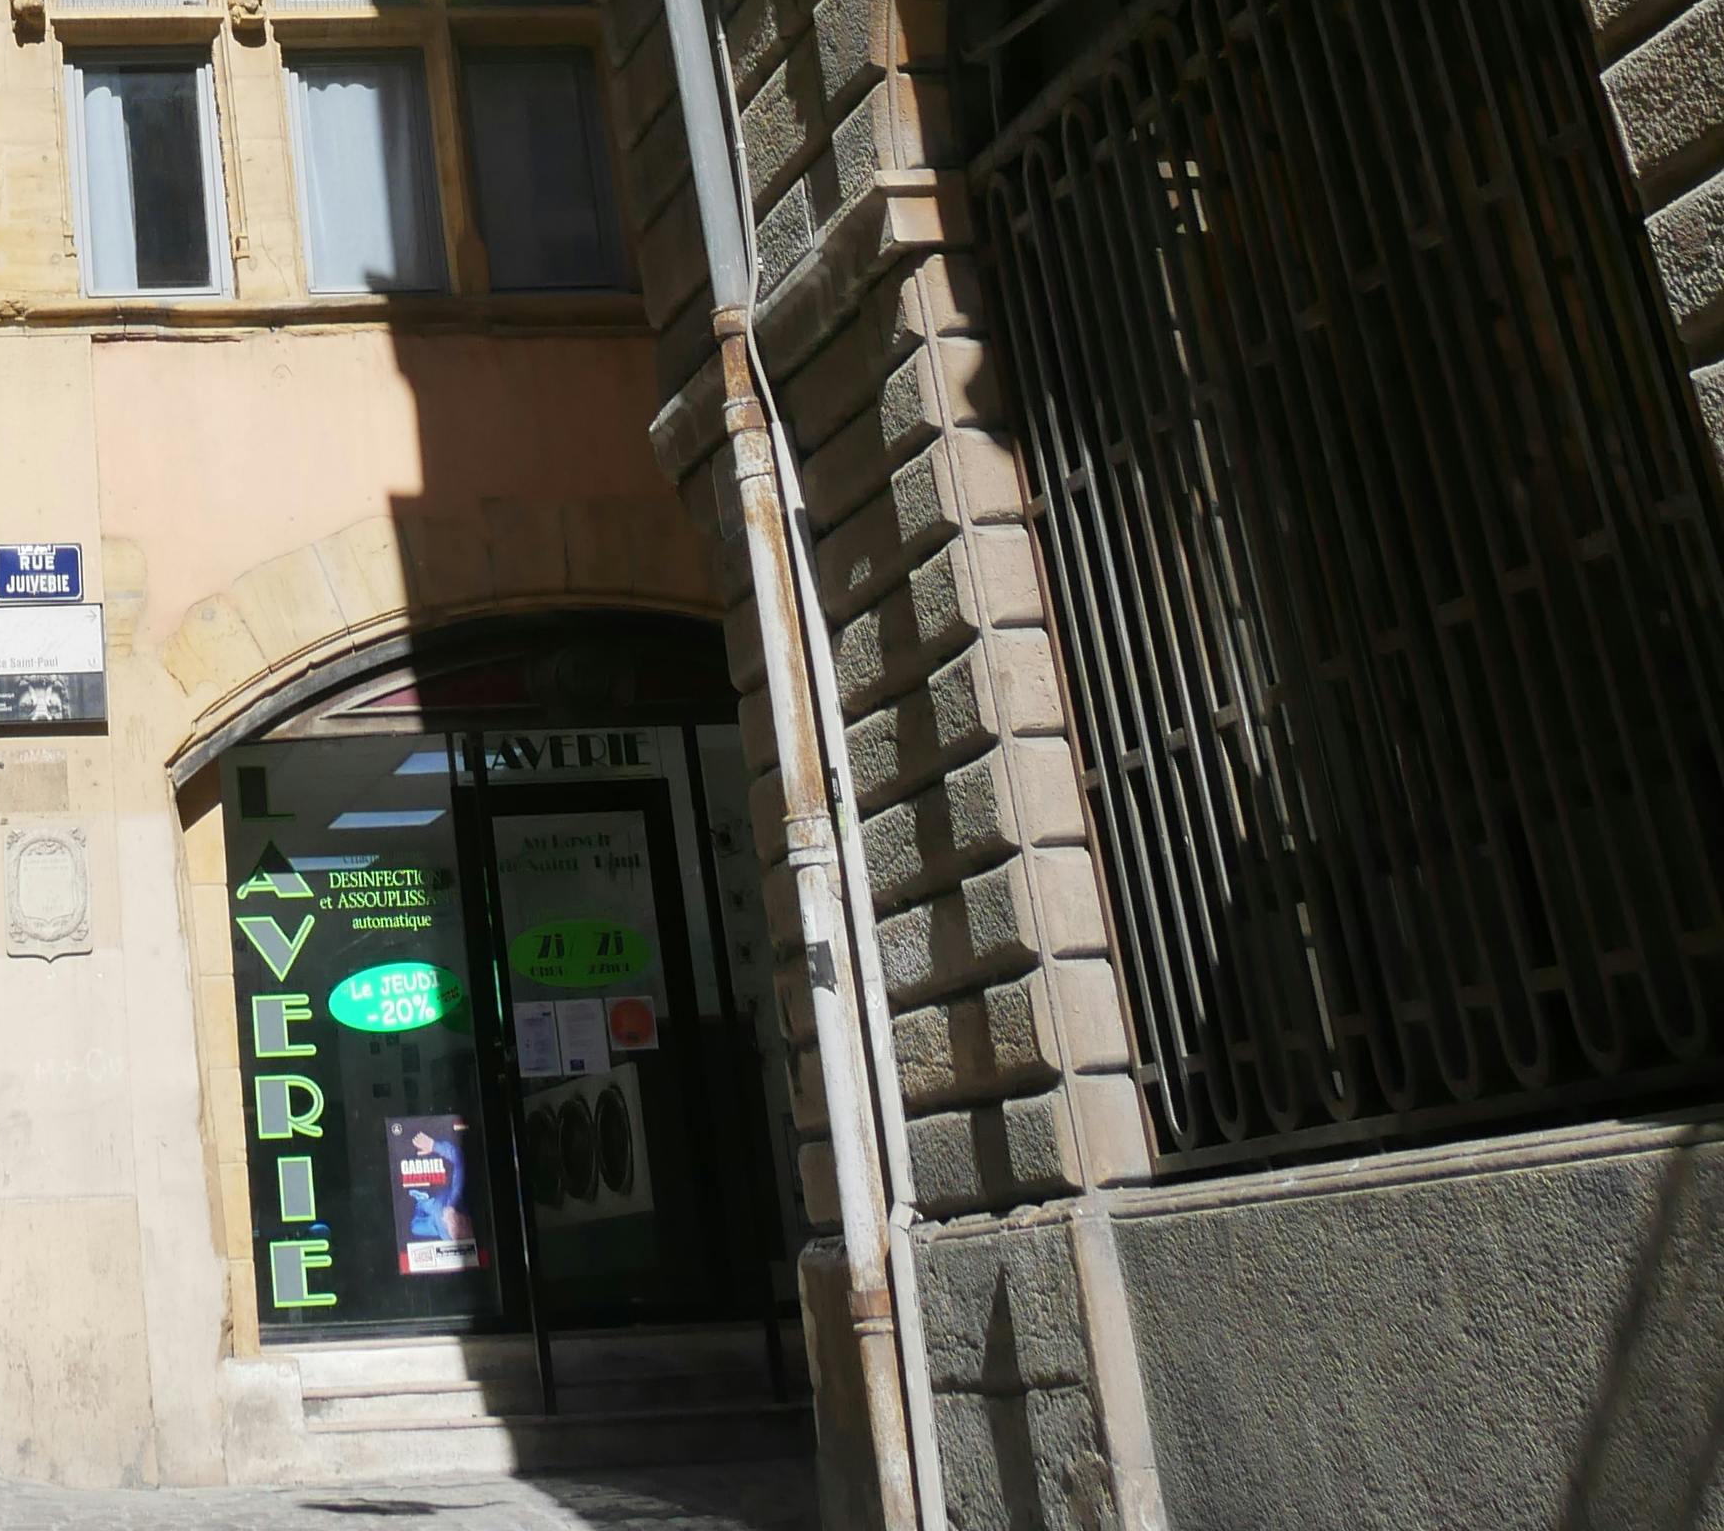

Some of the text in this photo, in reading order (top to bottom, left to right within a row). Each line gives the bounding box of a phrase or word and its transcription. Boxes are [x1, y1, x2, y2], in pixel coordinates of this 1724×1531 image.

[19, 555, 55, 571] RUE
[10, 656, 59, 669] Saint-Paul
[460, 732, 651, 773] LAVERIE
[329, 869, 447, 889] DESINFECTION
[319, 895, 333, 910] et
[352, 912, 432, 931] automatique
[380, 970, 439, 996] JEUDI
[235, 766, 338, 1308] LAVERIE
[400, 1158, 446, 1175] GABRIEL
